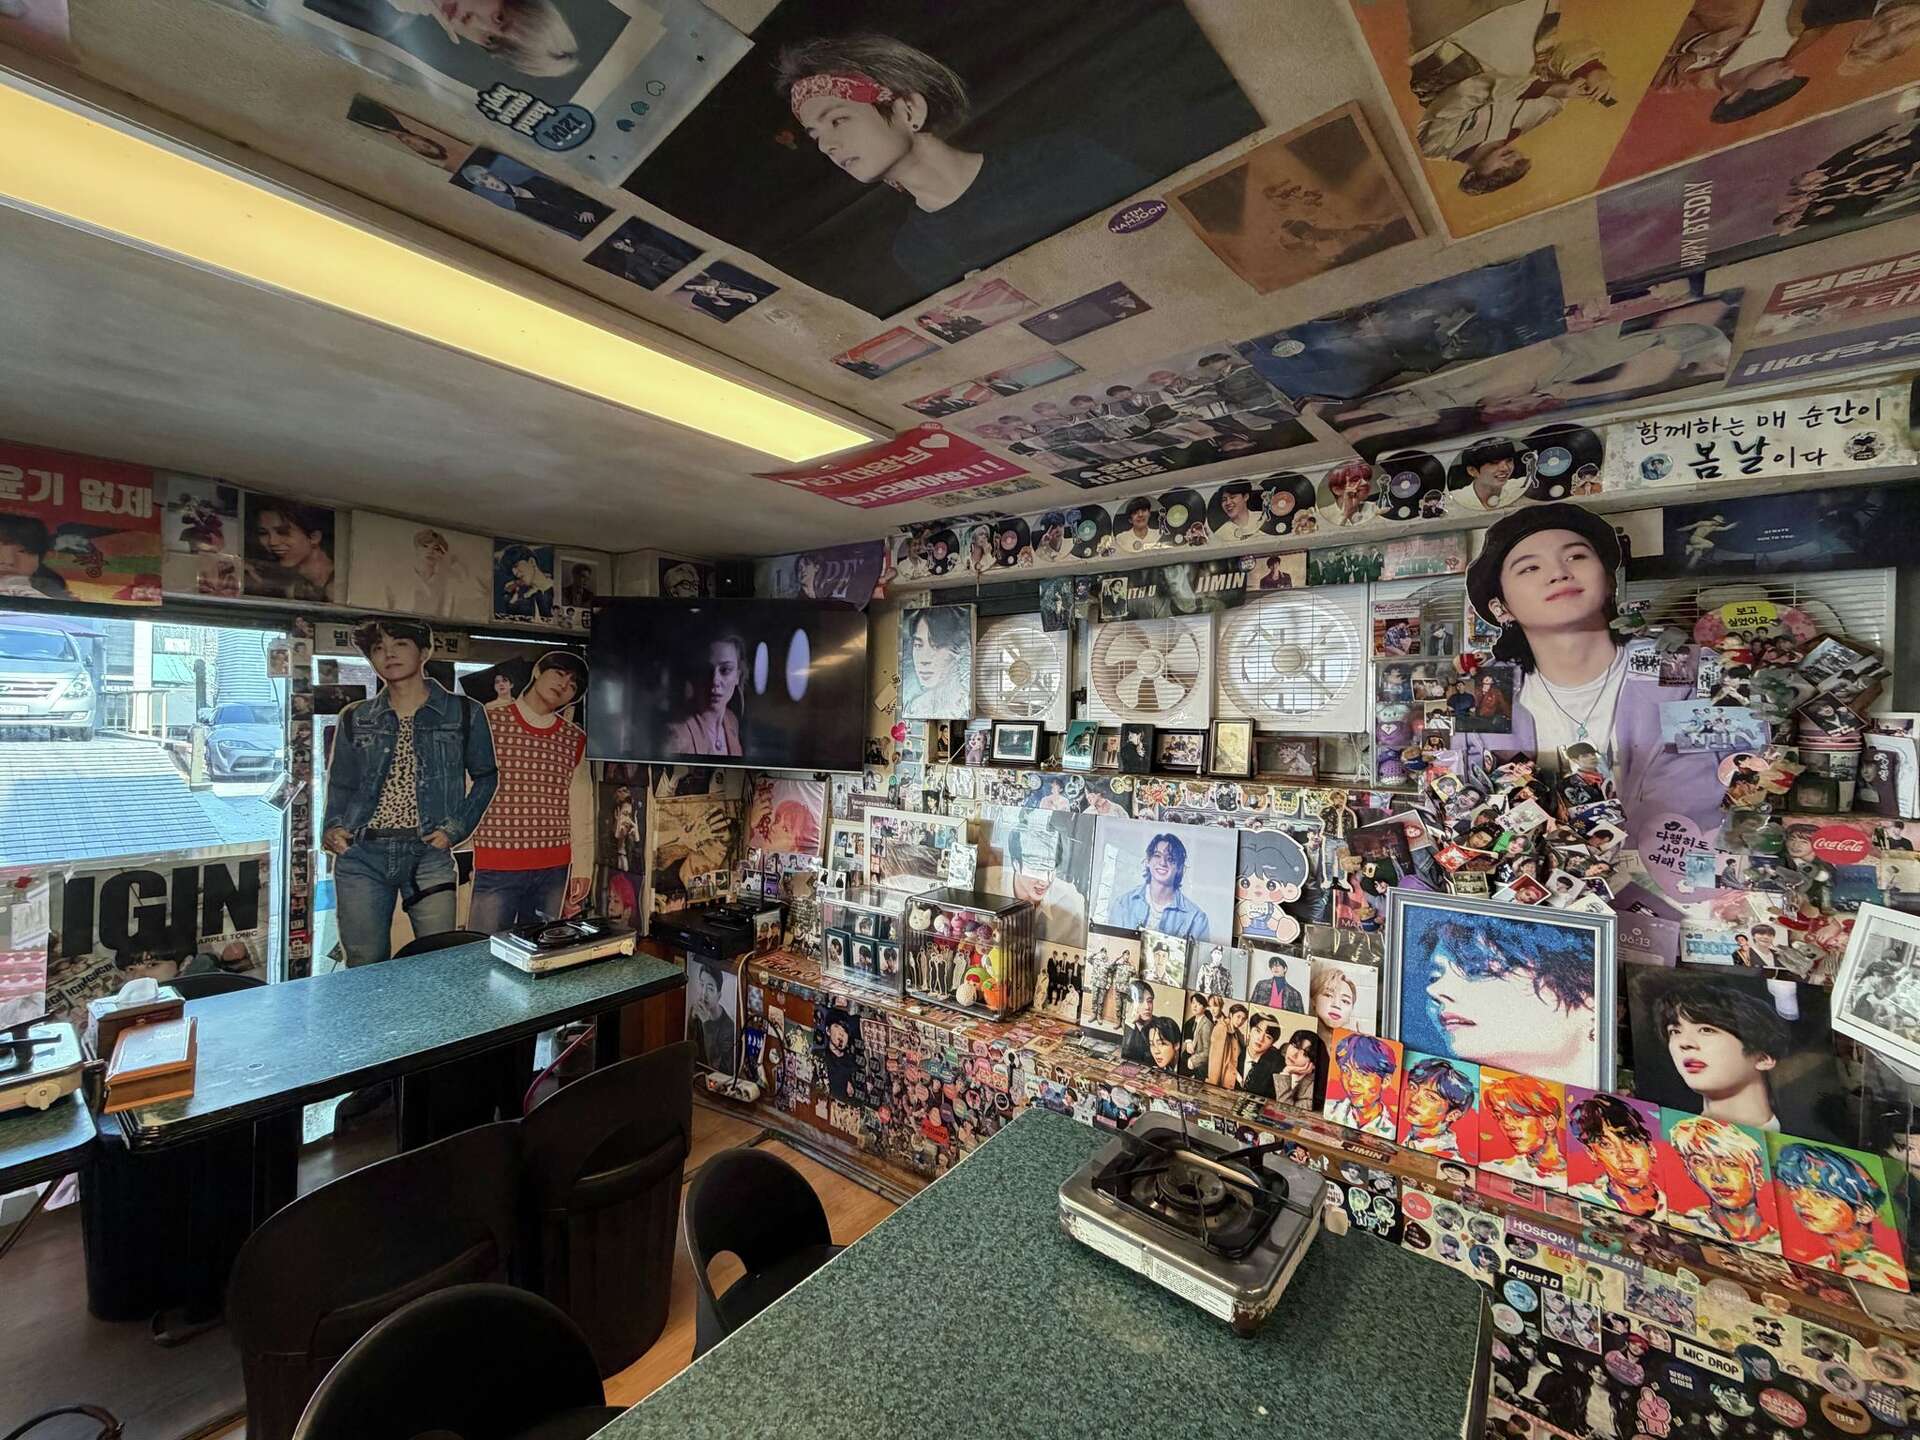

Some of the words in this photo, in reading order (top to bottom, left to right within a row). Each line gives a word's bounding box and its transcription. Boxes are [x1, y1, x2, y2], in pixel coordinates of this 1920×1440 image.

[1111, 203, 1166, 232] NAMJOON
[1122, 206, 1144, 220] KIM
[1681, 180, 1713, 236] BTSDAY
[1680, 237, 1709, 268] HAPPY
[1637, 416, 1745, 446] 함께하는
[1756, 410, 1786, 429] 매
[1798, 397, 1882, 428] 순간이
[1195, 572, 1246, 594] JIMIN
[1656, 831, 1710, 851] 다행히도
[1346, 1144, 1384, 1161] JIMIN
[1513, 1219, 1569, 1247] HOSEOK
[1508, 1264, 1548, 1286] Agust
[1549, 1276, 1560, 1288] D
[1682, 1346, 1705, 1362] MIC
[1708, 1356, 1739, 1375] DROP
